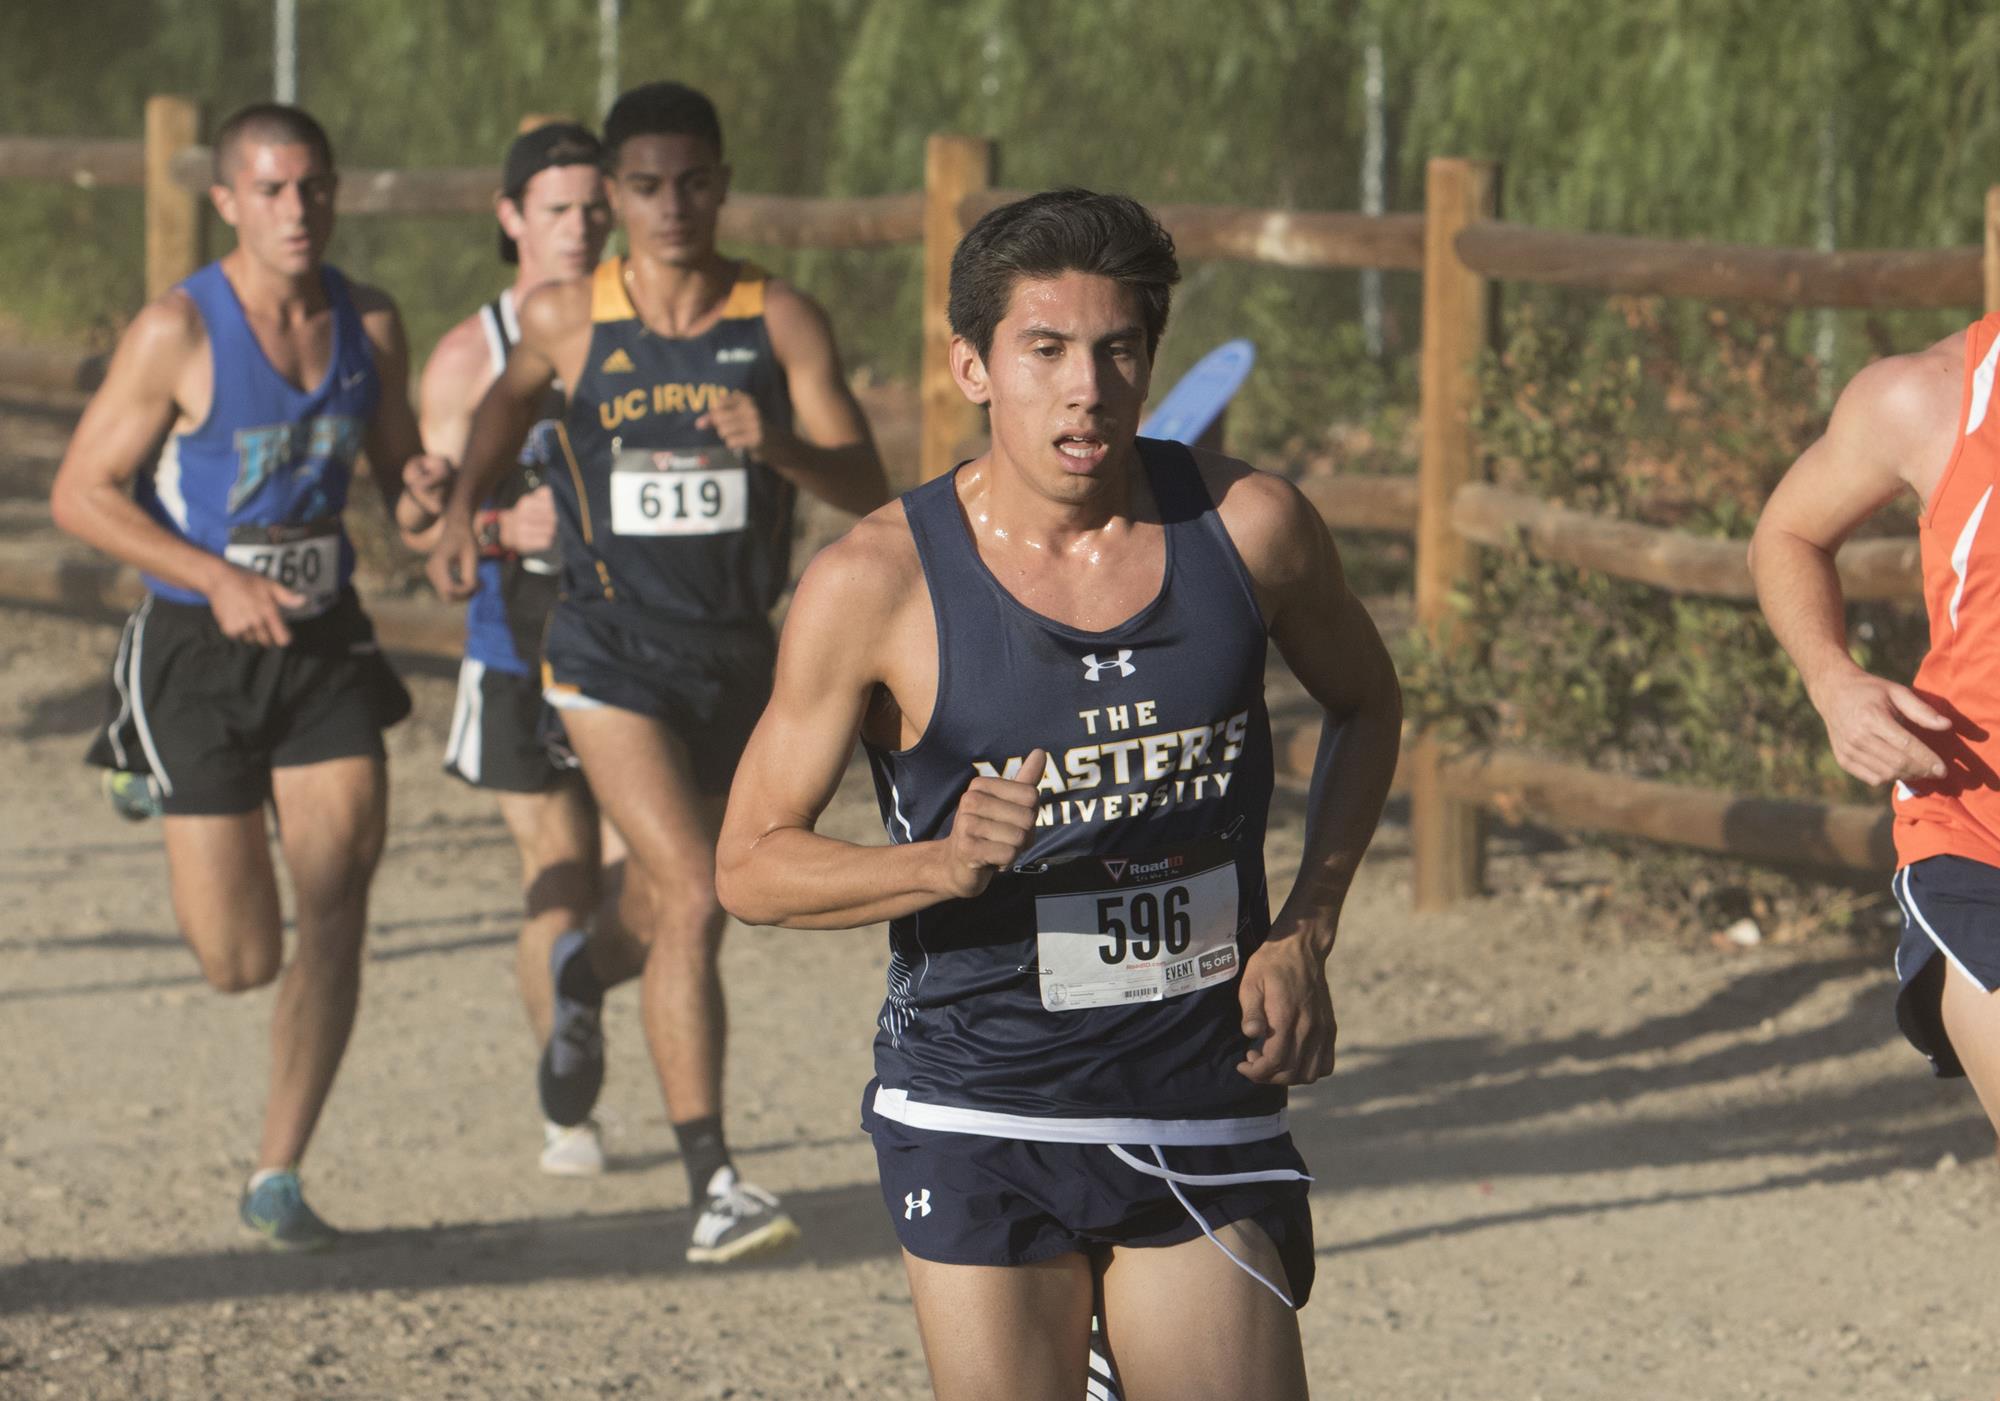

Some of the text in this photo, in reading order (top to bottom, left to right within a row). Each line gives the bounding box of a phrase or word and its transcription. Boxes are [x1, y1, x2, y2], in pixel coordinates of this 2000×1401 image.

[599, 383, 730, 430] UC IRVI
[640, 479, 722, 519] 619
[253, 548, 321, 584] 760
[1079, 700, 1158, 735] THE
[1035, 771, 1233, 827] NIVERSITY
[1097, 886, 1191, 965] 596
[1165, 960, 1194, 981] EVENT
[1214, 953, 1234, 967] OFF
